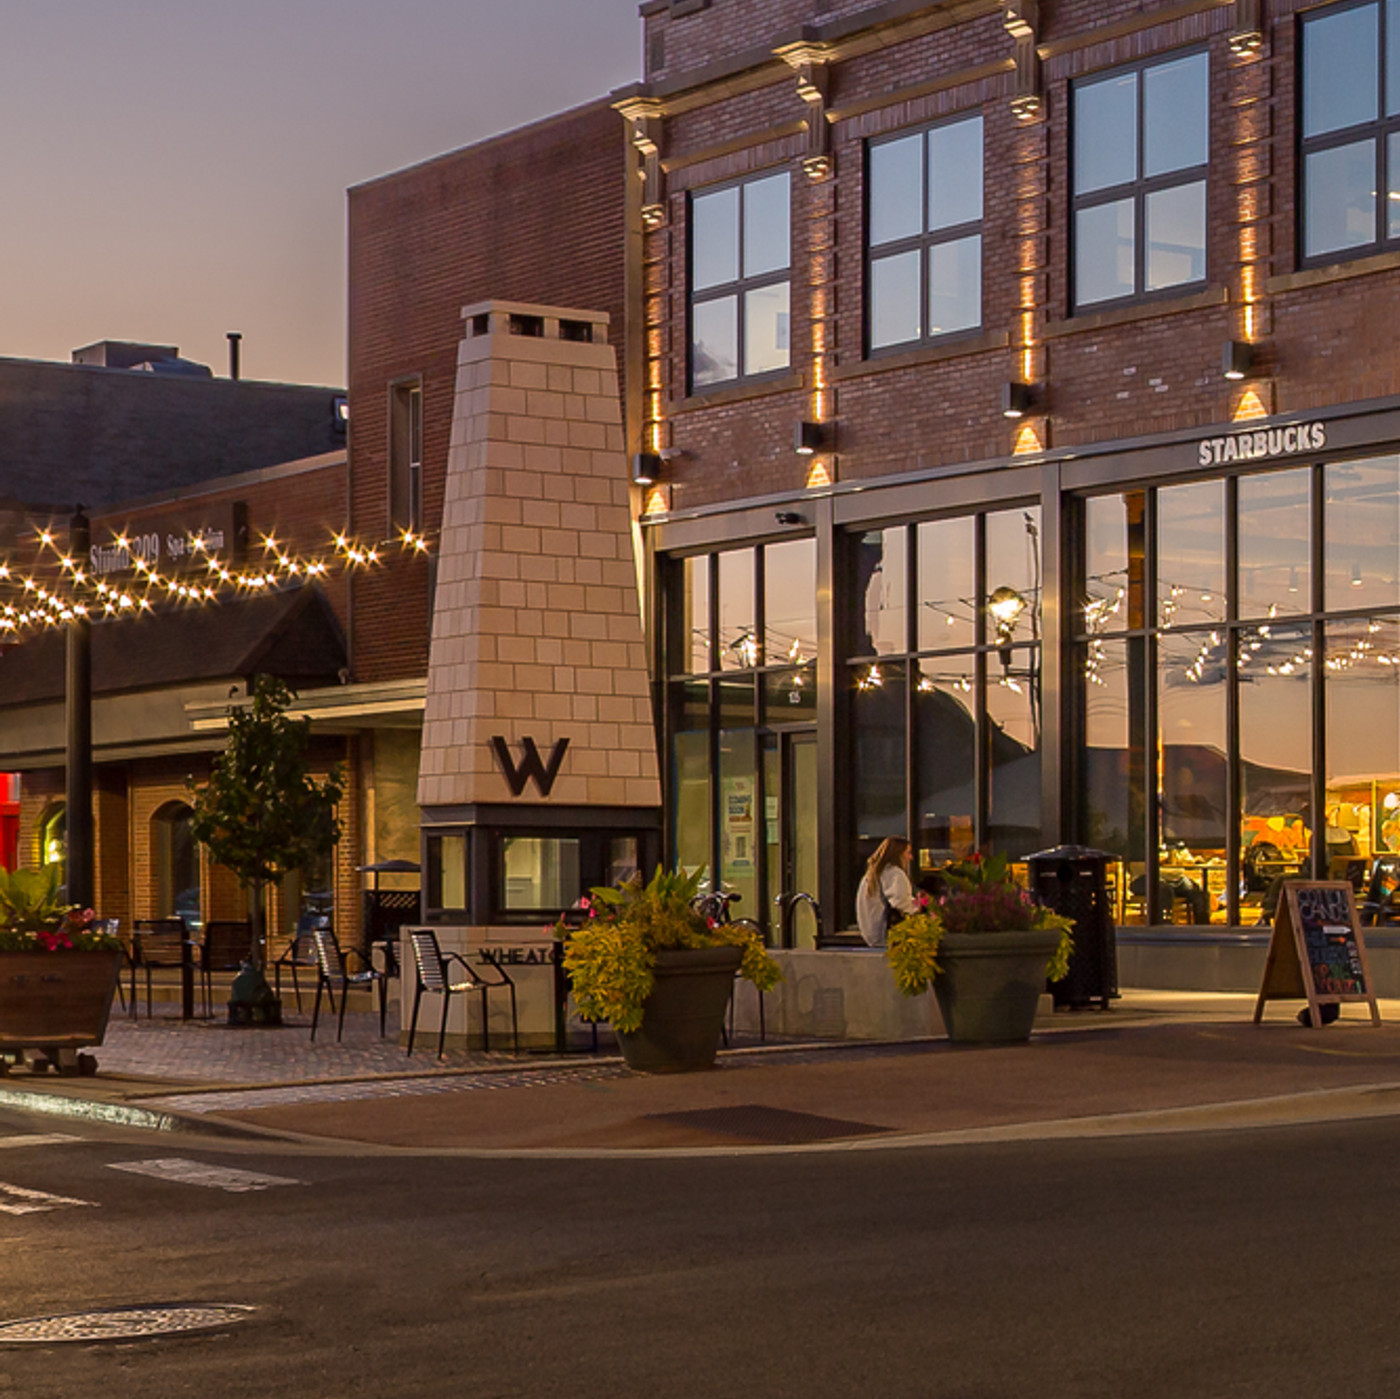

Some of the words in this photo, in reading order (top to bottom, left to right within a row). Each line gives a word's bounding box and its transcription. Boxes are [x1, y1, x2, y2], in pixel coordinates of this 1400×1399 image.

[1199, 423, 1326, 466] STARBUCKS
[166, 533, 185, 561] Spa
[487, 735, 571, 797] W
